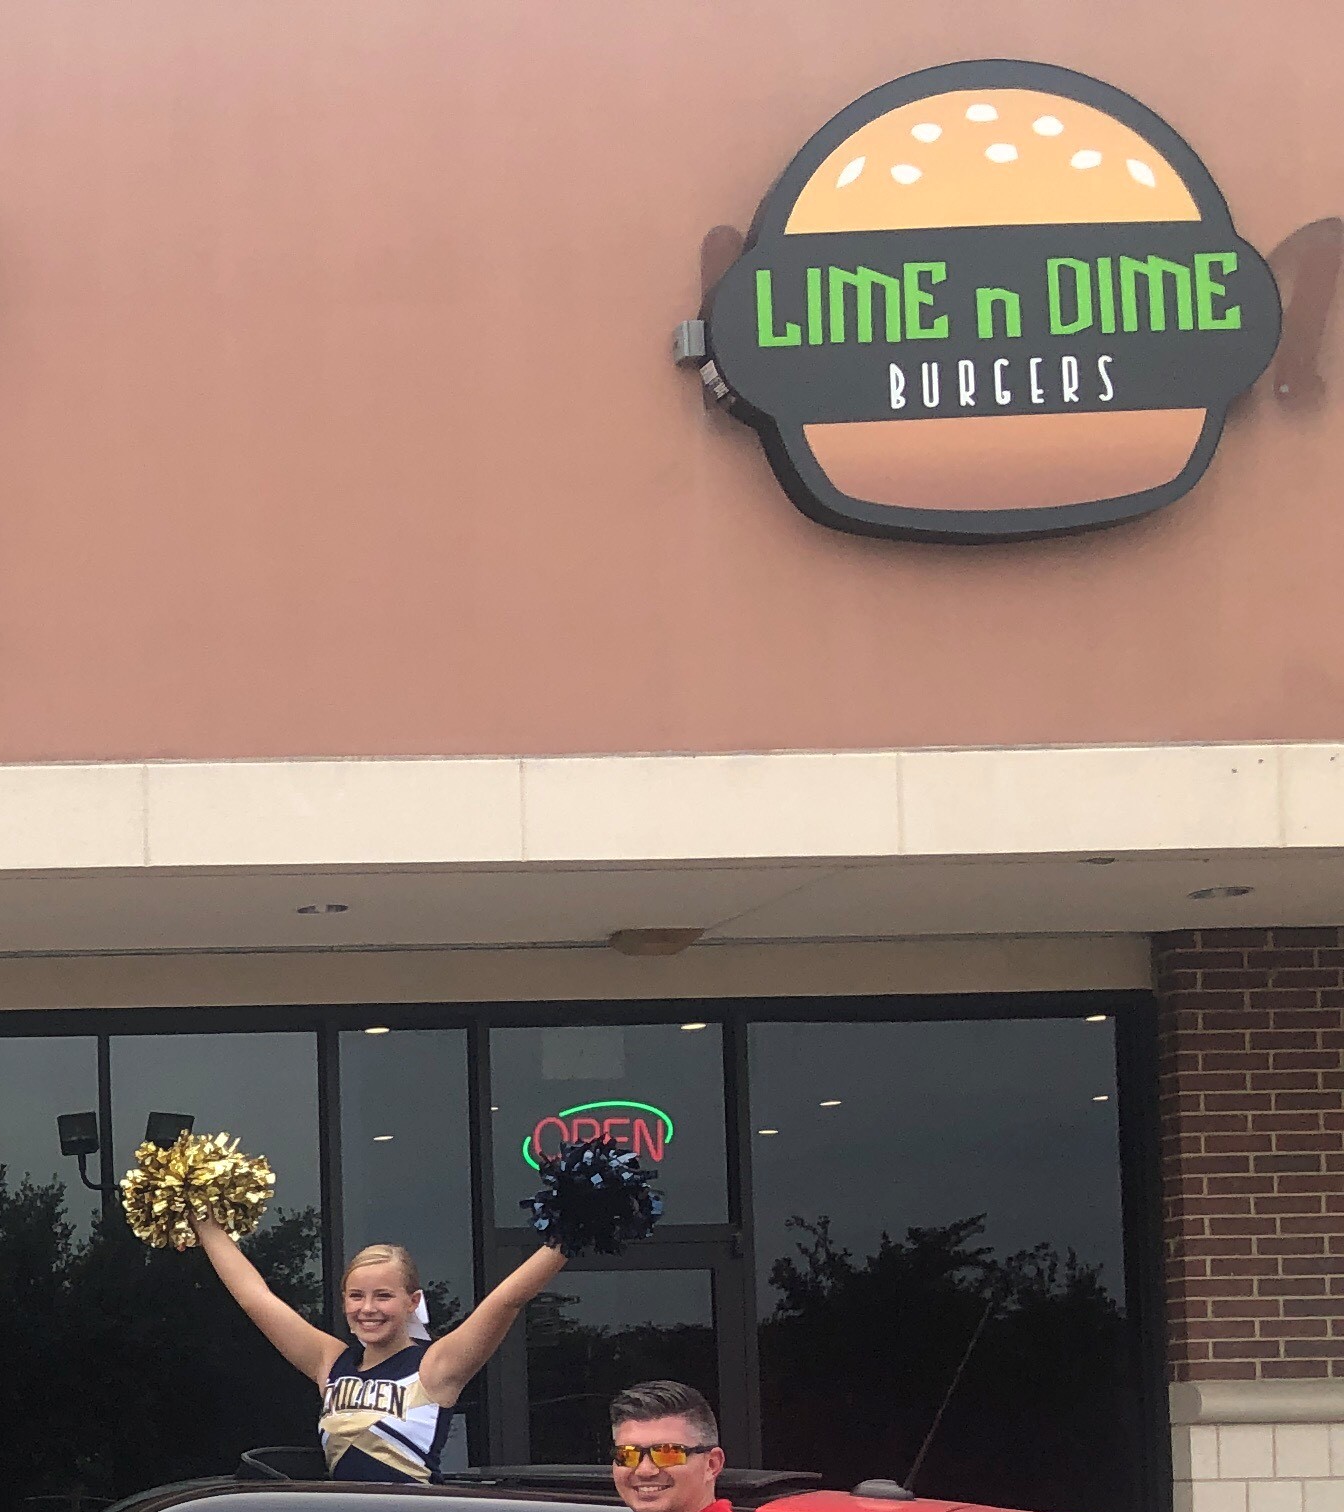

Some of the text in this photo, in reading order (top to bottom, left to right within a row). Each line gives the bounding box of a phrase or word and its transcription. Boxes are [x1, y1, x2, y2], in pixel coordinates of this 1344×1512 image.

[756, 261, 949, 347] LIME
[1046, 252, 1241, 335] DIME
[889, 355, 1115, 409] BURGERS
